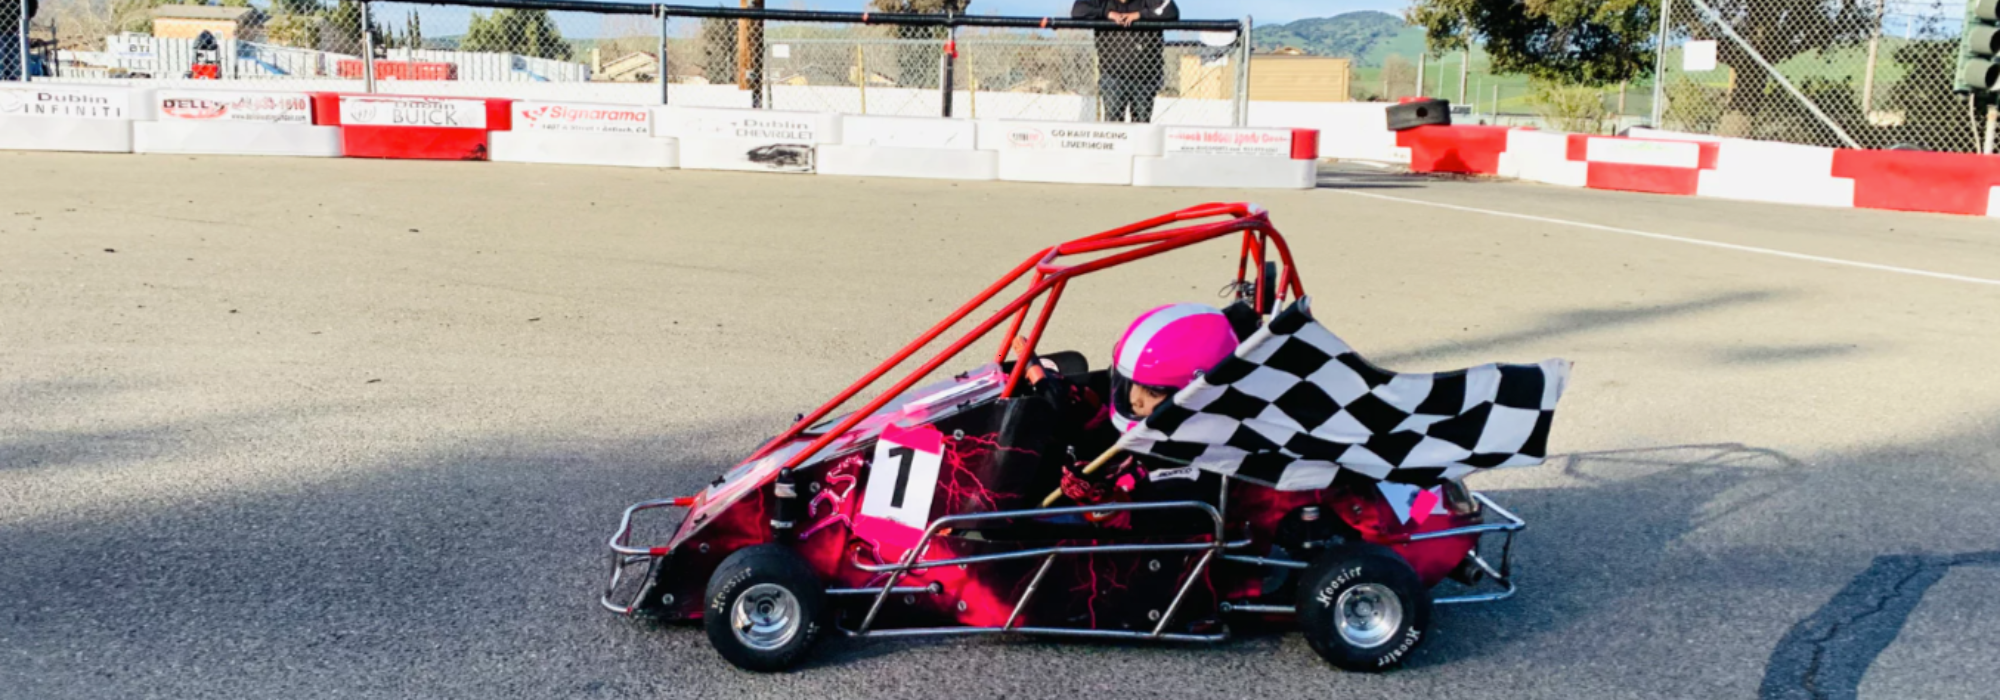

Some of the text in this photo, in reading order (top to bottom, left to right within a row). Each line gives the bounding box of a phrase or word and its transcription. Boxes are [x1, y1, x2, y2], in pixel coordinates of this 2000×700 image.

[37, 92, 108, 104] Dublin
[24, 103, 121, 117] INFINITI
[393, 108, 458, 126] BUICK
[550, 105, 647, 122] Signarama
[743, 119, 809, 130] Dublin
[735, 128, 814, 140] CHEVROLET
[1051, 129, 1066, 138] GO
[1093, 131, 1128, 140] RACING
[1061, 140, 1115, 151] LIVERMORE
[889, 446, 915, 509] 1
[1316, 566, 1362, 608] Hoosier
[1378, 626, 1421, 667] Hoosier
